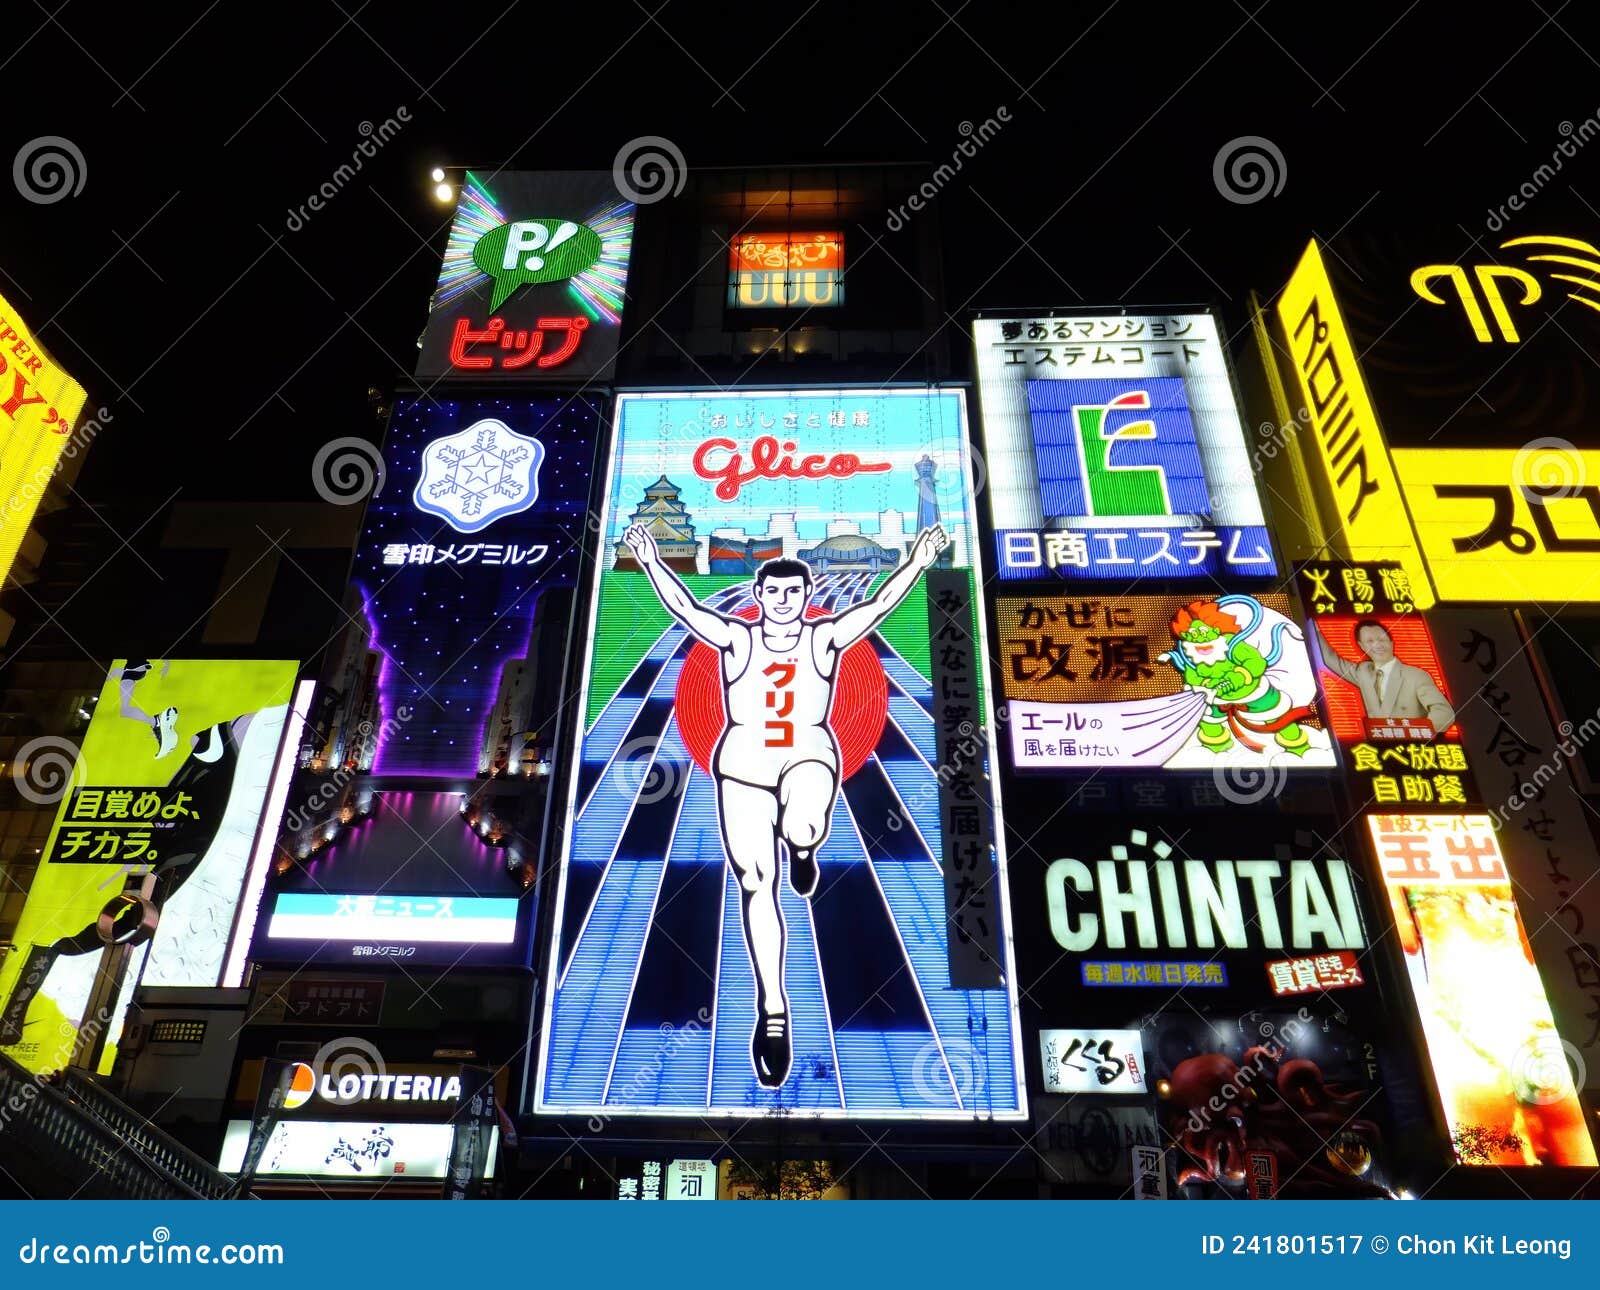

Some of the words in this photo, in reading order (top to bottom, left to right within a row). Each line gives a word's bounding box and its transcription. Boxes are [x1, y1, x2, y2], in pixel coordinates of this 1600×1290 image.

[449, 316, 590, 369] ピップ
[1000, 319, 1194, 342] 夢あるマンション
[1004, 343, 1201, 367] エステムコート
[711, 411, 870, 428] おいしさと健康
[382, 542, 549, 565] 雪印メグミルク
[1004, 529, 1272, 569] 日商エステム
[1016, 601, 1136, 629] かぜに
[1007, 634, 1156, 683] 改源
[762, 657, 799, 748] グリコ
[1021, 711, 1104, 732] エールの
[1024, 738, 1121, 757] 風を届けたい
[1351, 743, 1469, 771] 食べ放題
[1372, 775, 1467, 803] 自助餐
[72, 791, 200, 820] 目覚めよ、
[60, 831, 158, 860] チカラ。
[1379, 834, 1506, 880] 玉出
[352, 945, 416, 957] 雪印メグミルク
[1084, 963, 1223, 984] 毎週水曜日発売
[1061, 1038, 1125, 1085] くくる
[320, 1073, 462, 1101] LOTTERIA
[618, 1177, 639, 1200] 実
